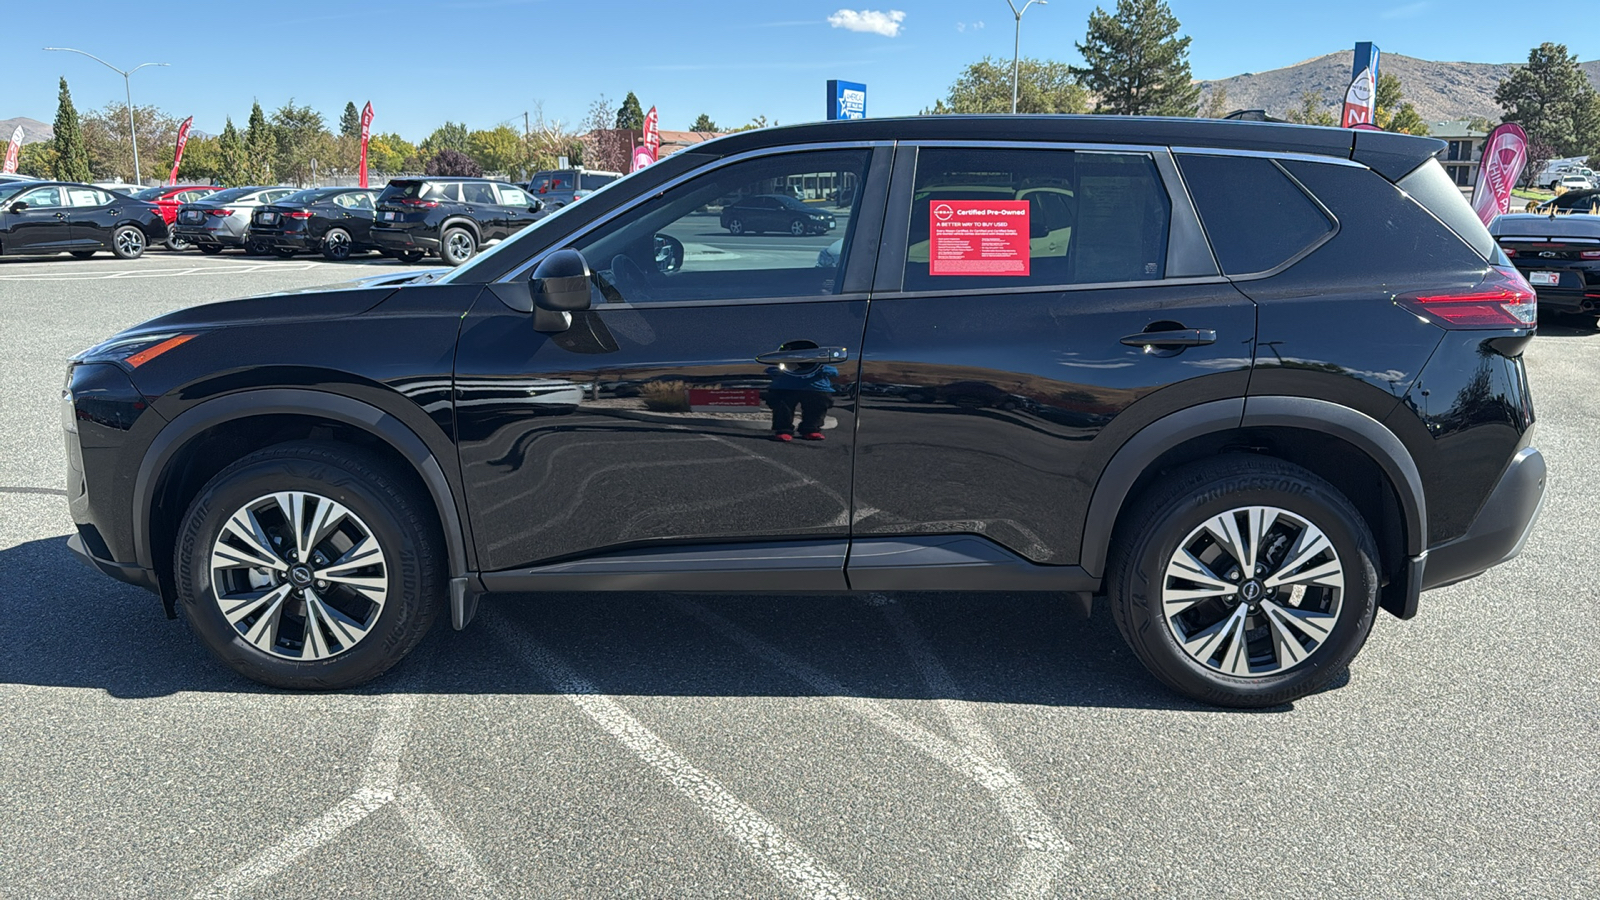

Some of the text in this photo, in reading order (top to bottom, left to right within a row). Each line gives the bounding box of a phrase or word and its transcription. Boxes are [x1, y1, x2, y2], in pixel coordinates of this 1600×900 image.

[1489, 157, 1507, 198] THINK
[1193, 478, 1313, 506] BRIDGESTONE
[180, 498, 211, 605] BRIDGESTONE
[380, 549, 416, 654] BRIDGESTONE
